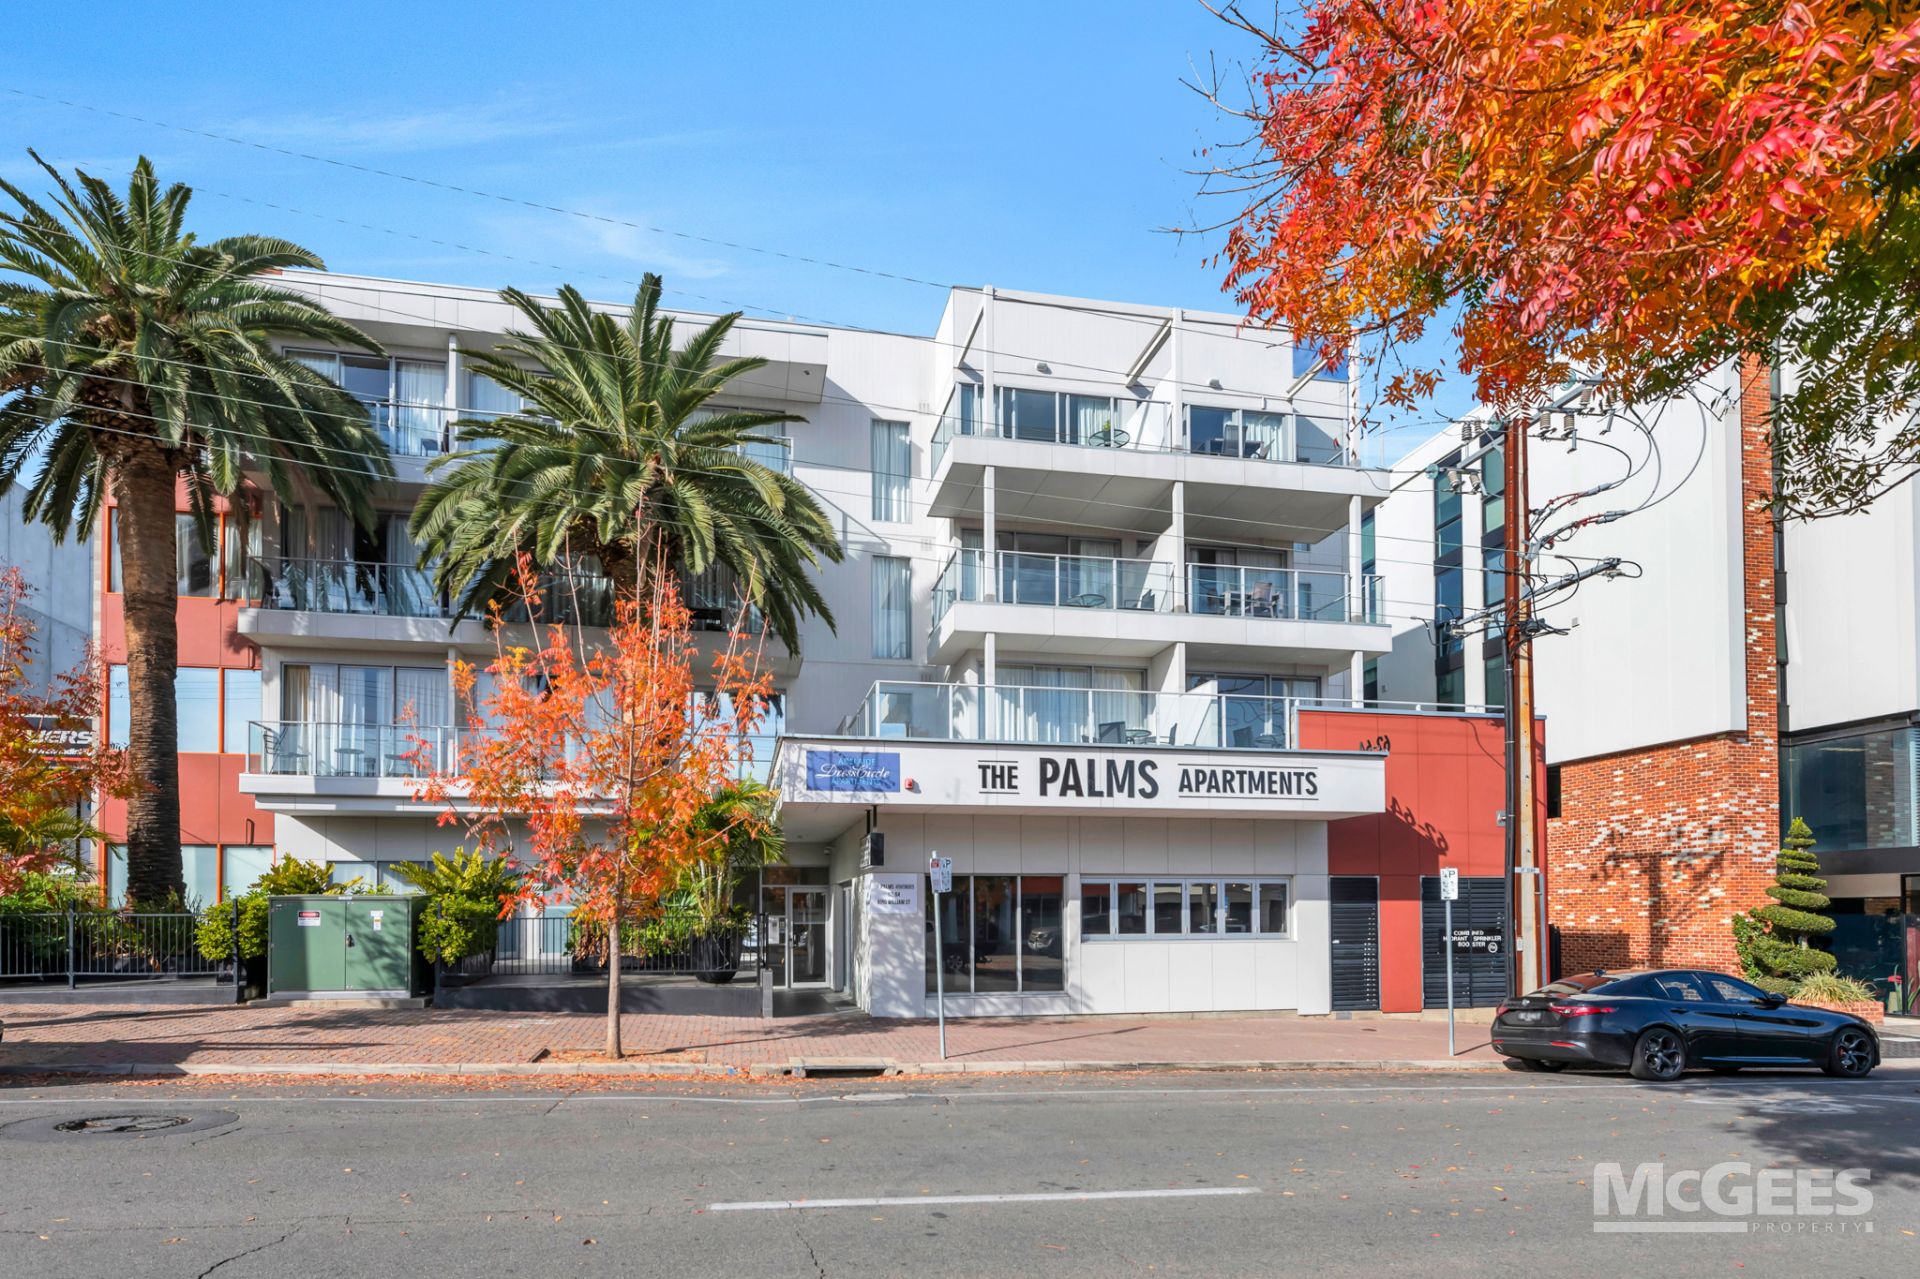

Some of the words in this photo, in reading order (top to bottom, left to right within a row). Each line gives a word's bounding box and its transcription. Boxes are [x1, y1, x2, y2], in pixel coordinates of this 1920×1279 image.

[978, 764, 1018, 790] THE
[1038, 757, 1159, 799] PALMS
[1177, 768, 1319, 796] APARTMENTS
